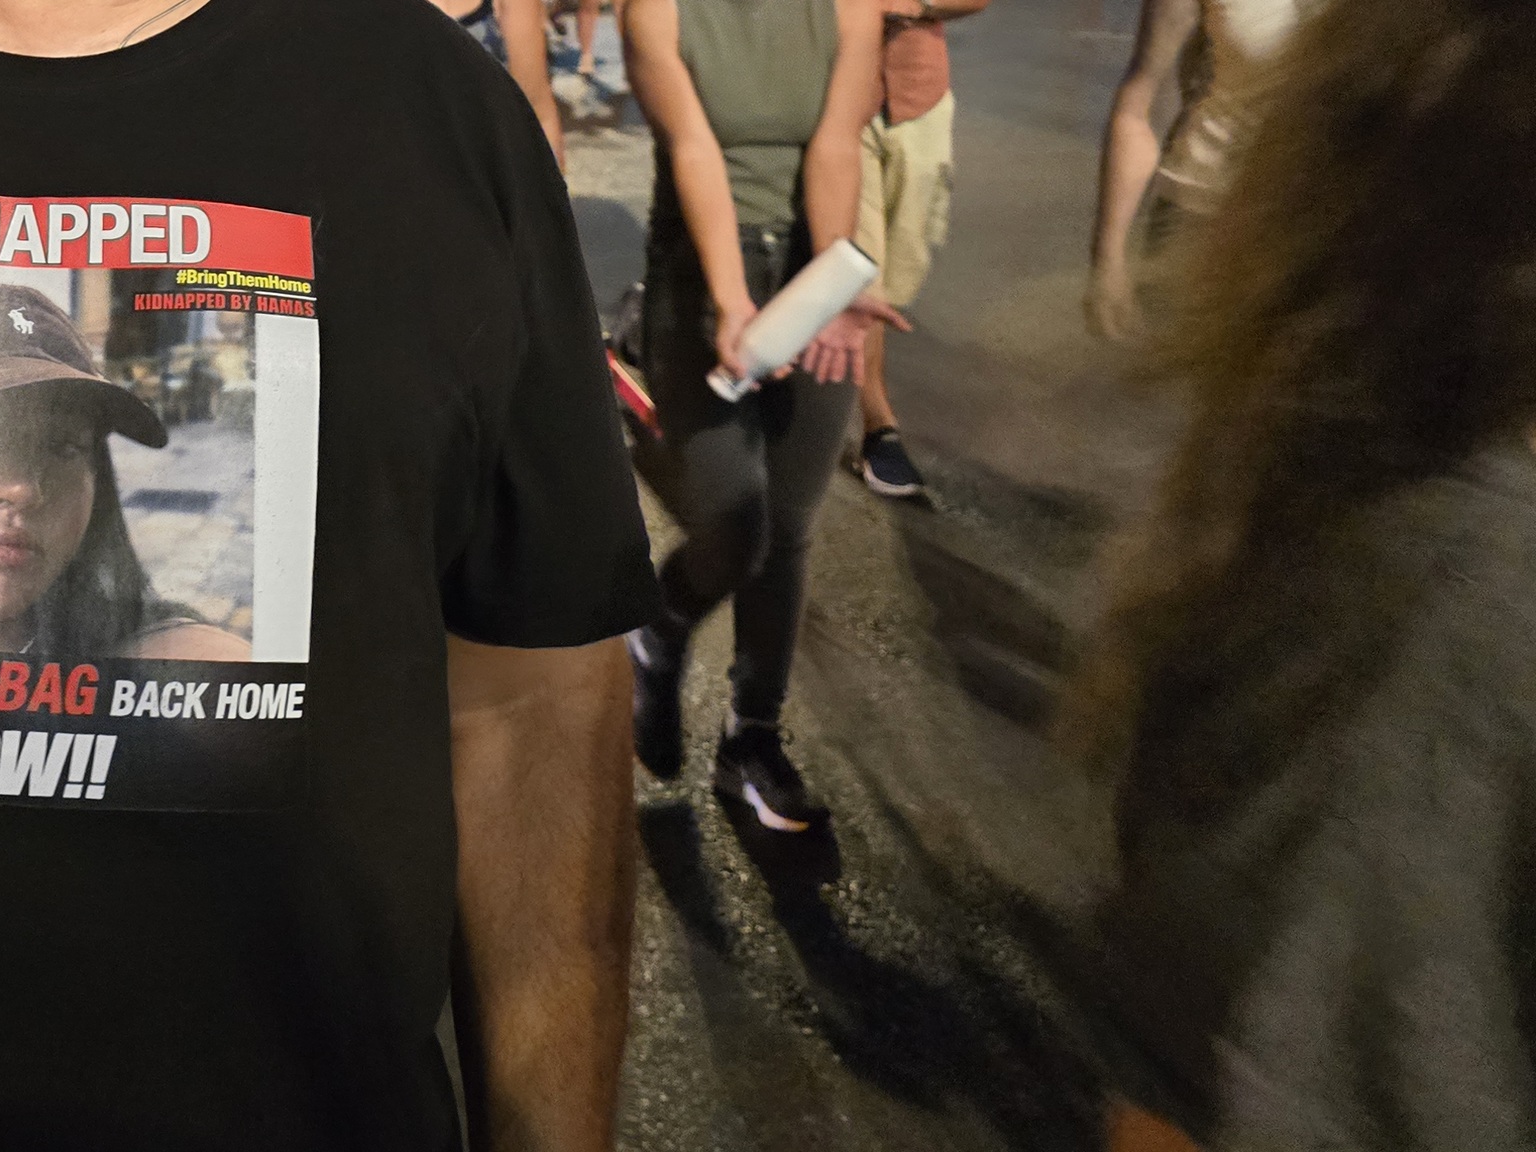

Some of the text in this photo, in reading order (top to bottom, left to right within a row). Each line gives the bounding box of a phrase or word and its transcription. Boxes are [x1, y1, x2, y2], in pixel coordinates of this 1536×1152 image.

[175, 269, 312, 294] #BringThemHome
[134, 294, 315, 317] KIDNAPPED BY HAMAS
[110, 679, 210, 720] BACK
[215, 683, 306, 720] HOME
